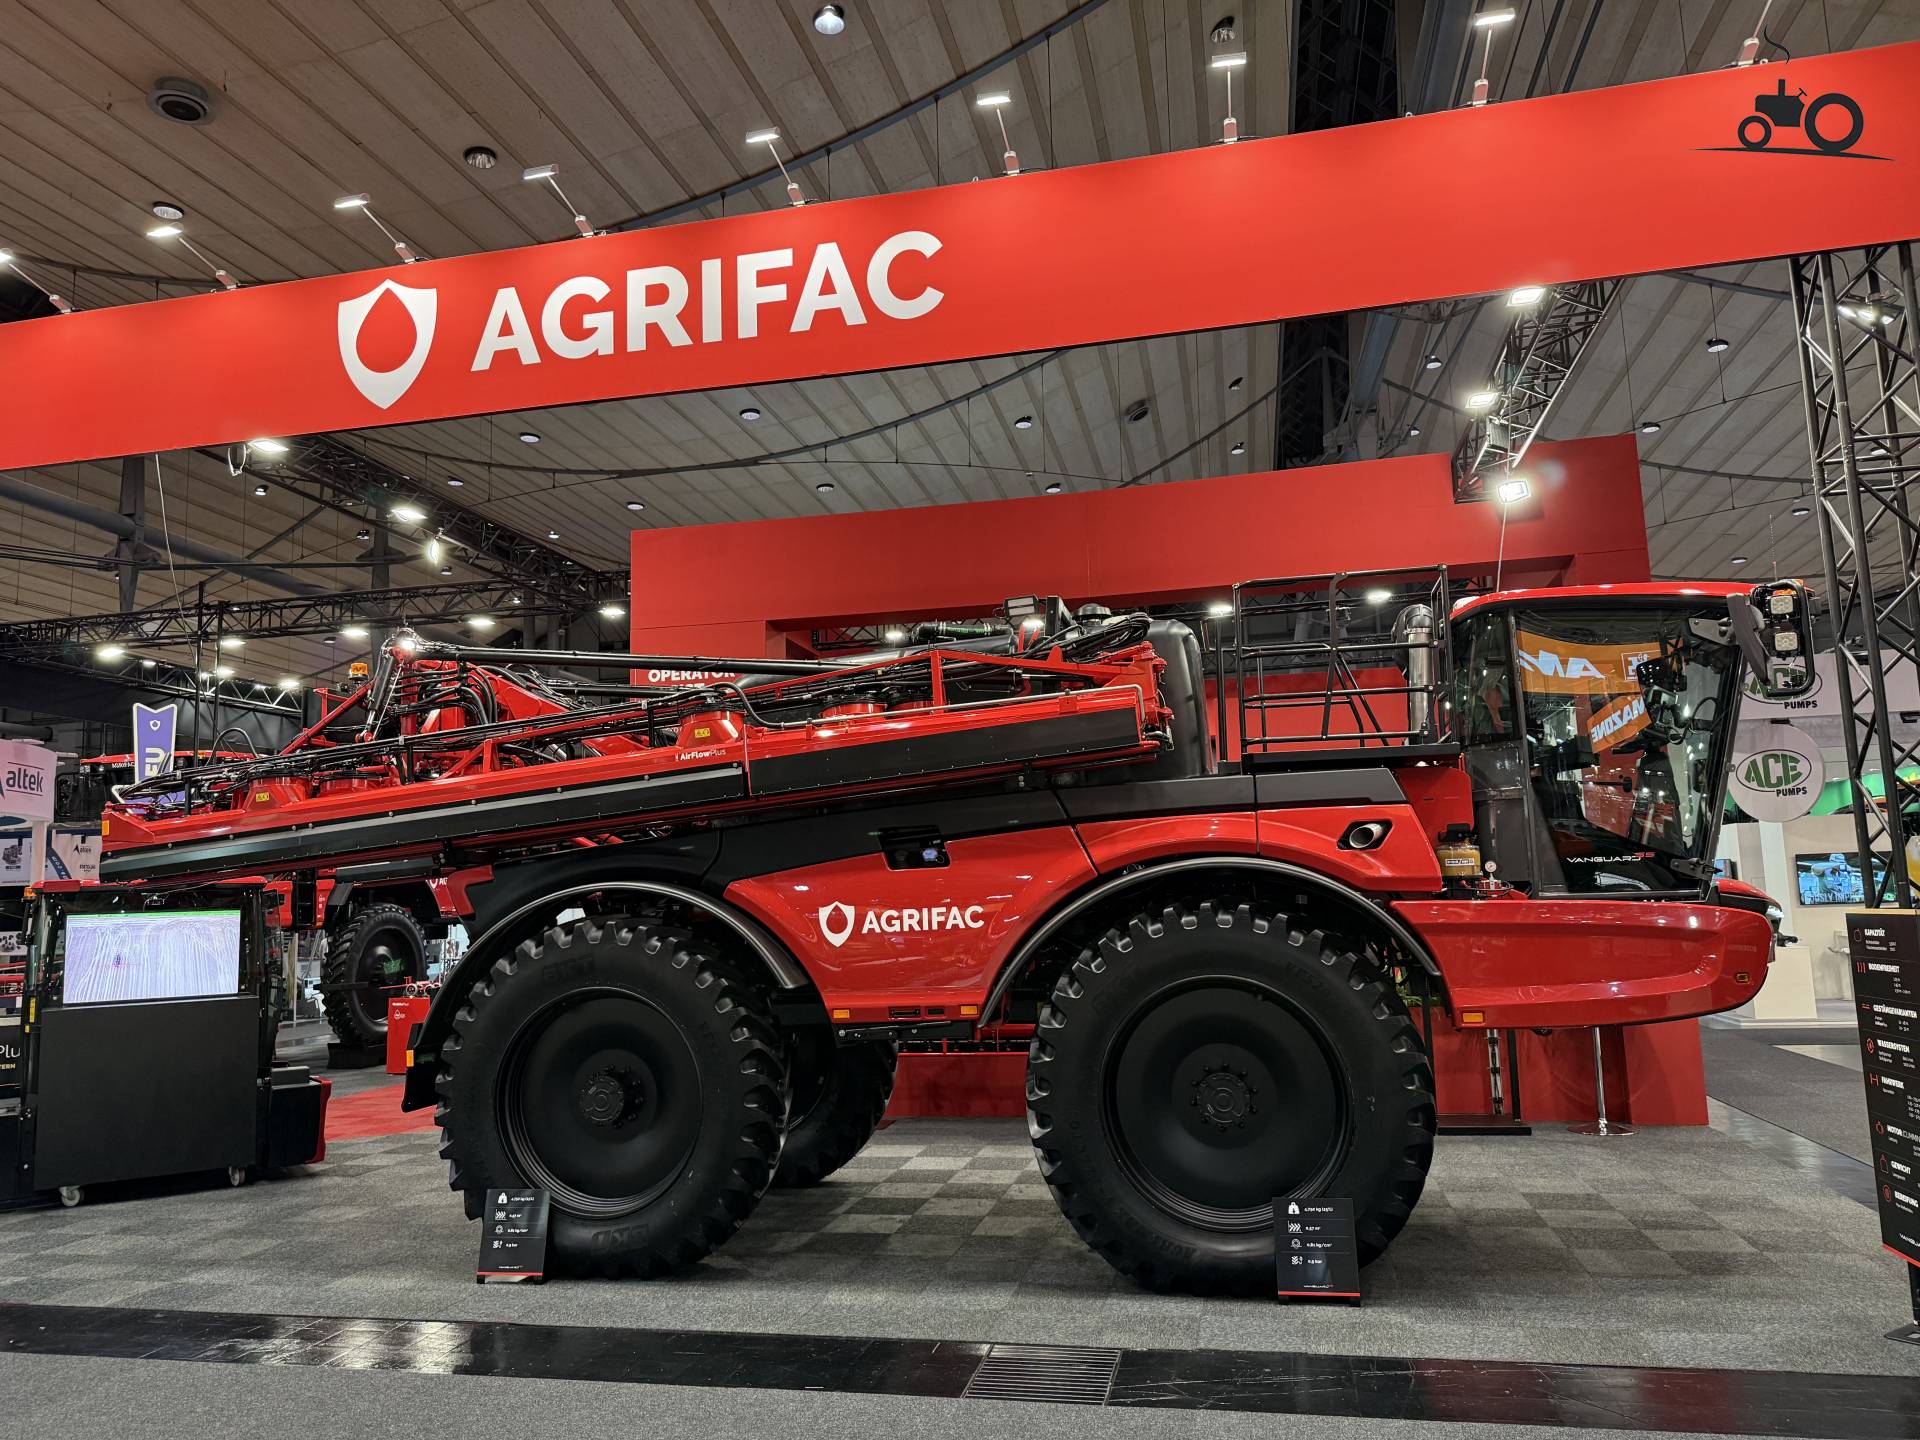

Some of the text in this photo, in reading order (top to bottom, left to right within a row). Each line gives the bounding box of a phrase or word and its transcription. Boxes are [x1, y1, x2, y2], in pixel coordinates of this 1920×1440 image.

[470, 230, 944, 372] AGRIFAC
[1784, 700, 1818, 709] PUMPS
[6, 767, 43, 793] altek
[1744, 753, 1803, 789] ACE
[1776, 787, 1808, 797] PUMPS
[861, 905, 985, 934] AGRIFAC
